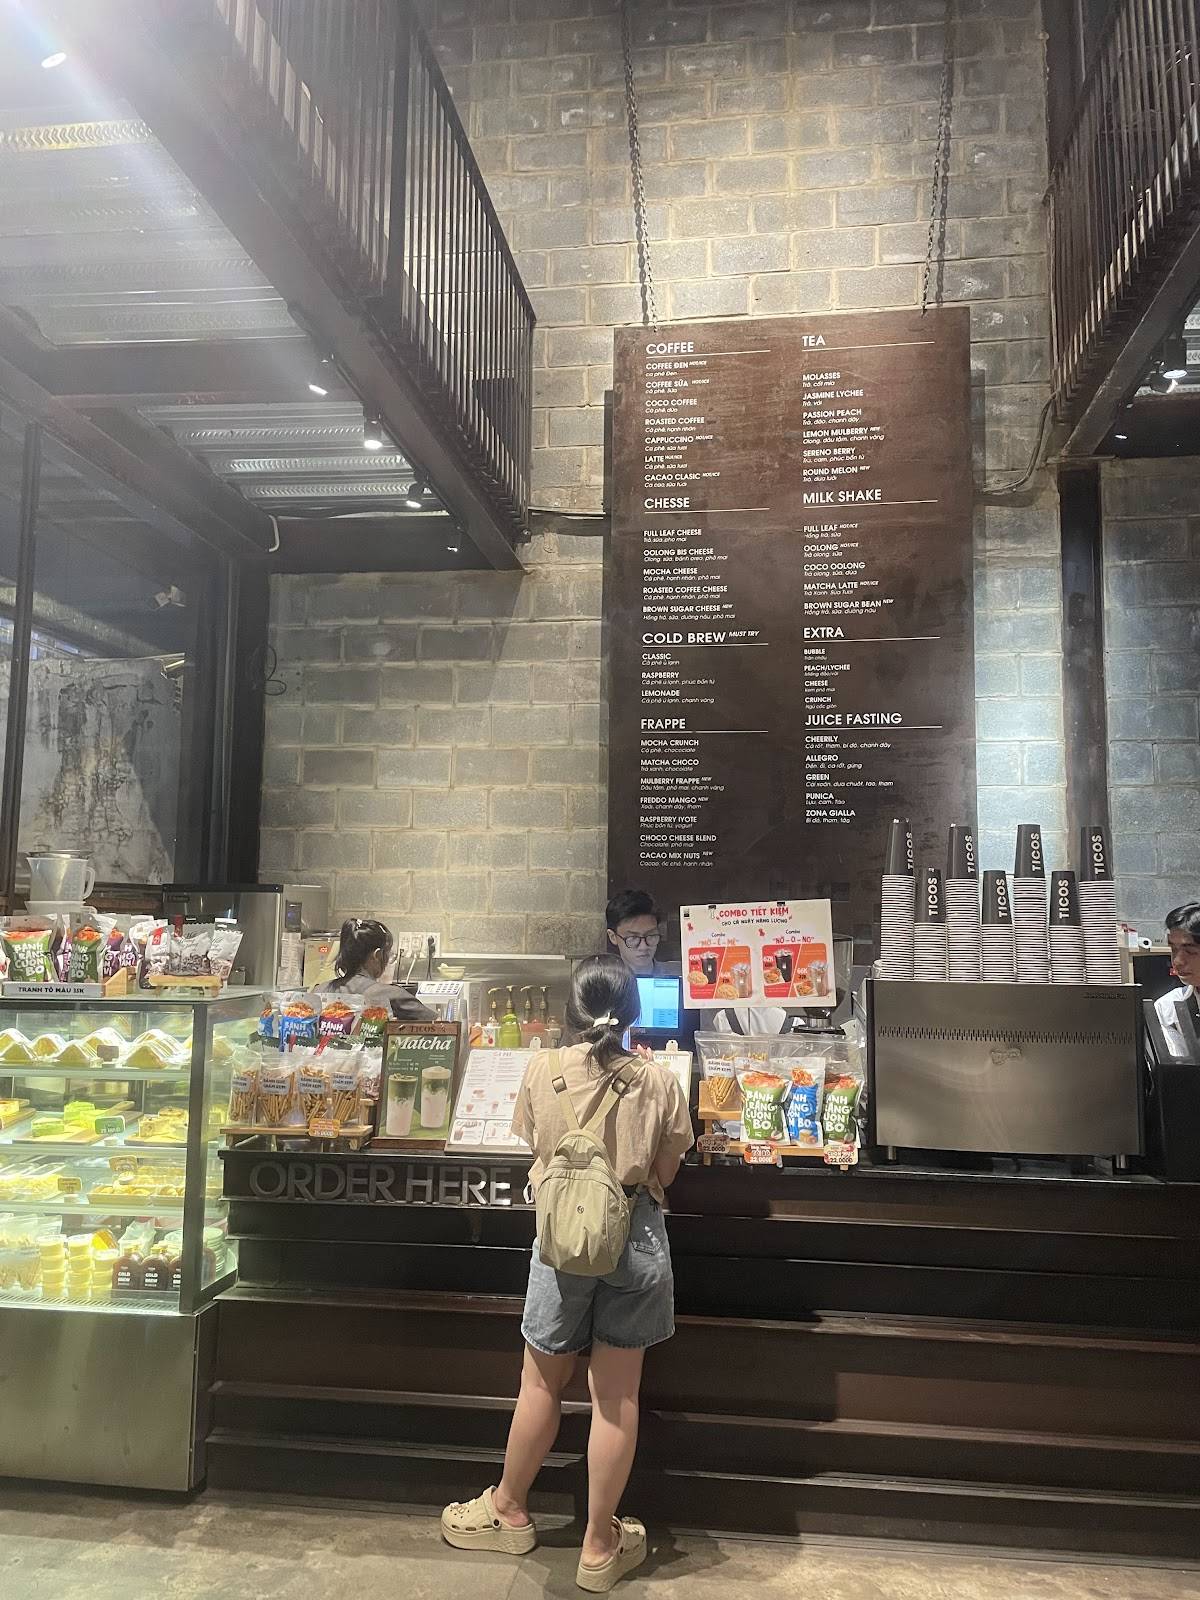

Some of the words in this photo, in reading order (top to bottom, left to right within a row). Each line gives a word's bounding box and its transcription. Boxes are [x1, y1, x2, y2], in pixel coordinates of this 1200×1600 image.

[802, 335, 825, 346] TEA
[646, 342, 694, 354] COFFEE
[803, 372, 840, 380] MOLASSES
[803, 391, 834, 400] JASMINE
[803, 492, 834, 503] MILK
[838, 489, 881, 502] SHAKE
[645, 498, 689, 508] CHESSE
[643, 633, 682, 643] COLD
[688, 632, 726, 643] BREW
[804, 627, 844, 638] EXTRA
[641, 719, 685, 729] FRAPPE
[805, 714, 842, 725] JUICE
[847, 713, 902, 724] FASTING
[965, 835, 975, 872] TICOS
[1031, 833, 1041, 871] TICOS
[1092, 835, 1105, 874] TICOS
[928, 877, 937, 915] TICOS
[996, 878, 1008, 918] TICOS
[1059, 880, 1069, 918] TICOS
[751, 906, 766, 916] TIẾT
[770, 907, 788, 916] KIỆM
[395, 1036, 451, 1050] Matcha
[251, 1161, 396, 1201] ORDER
[406, 1163, 511, 1206] HERE
